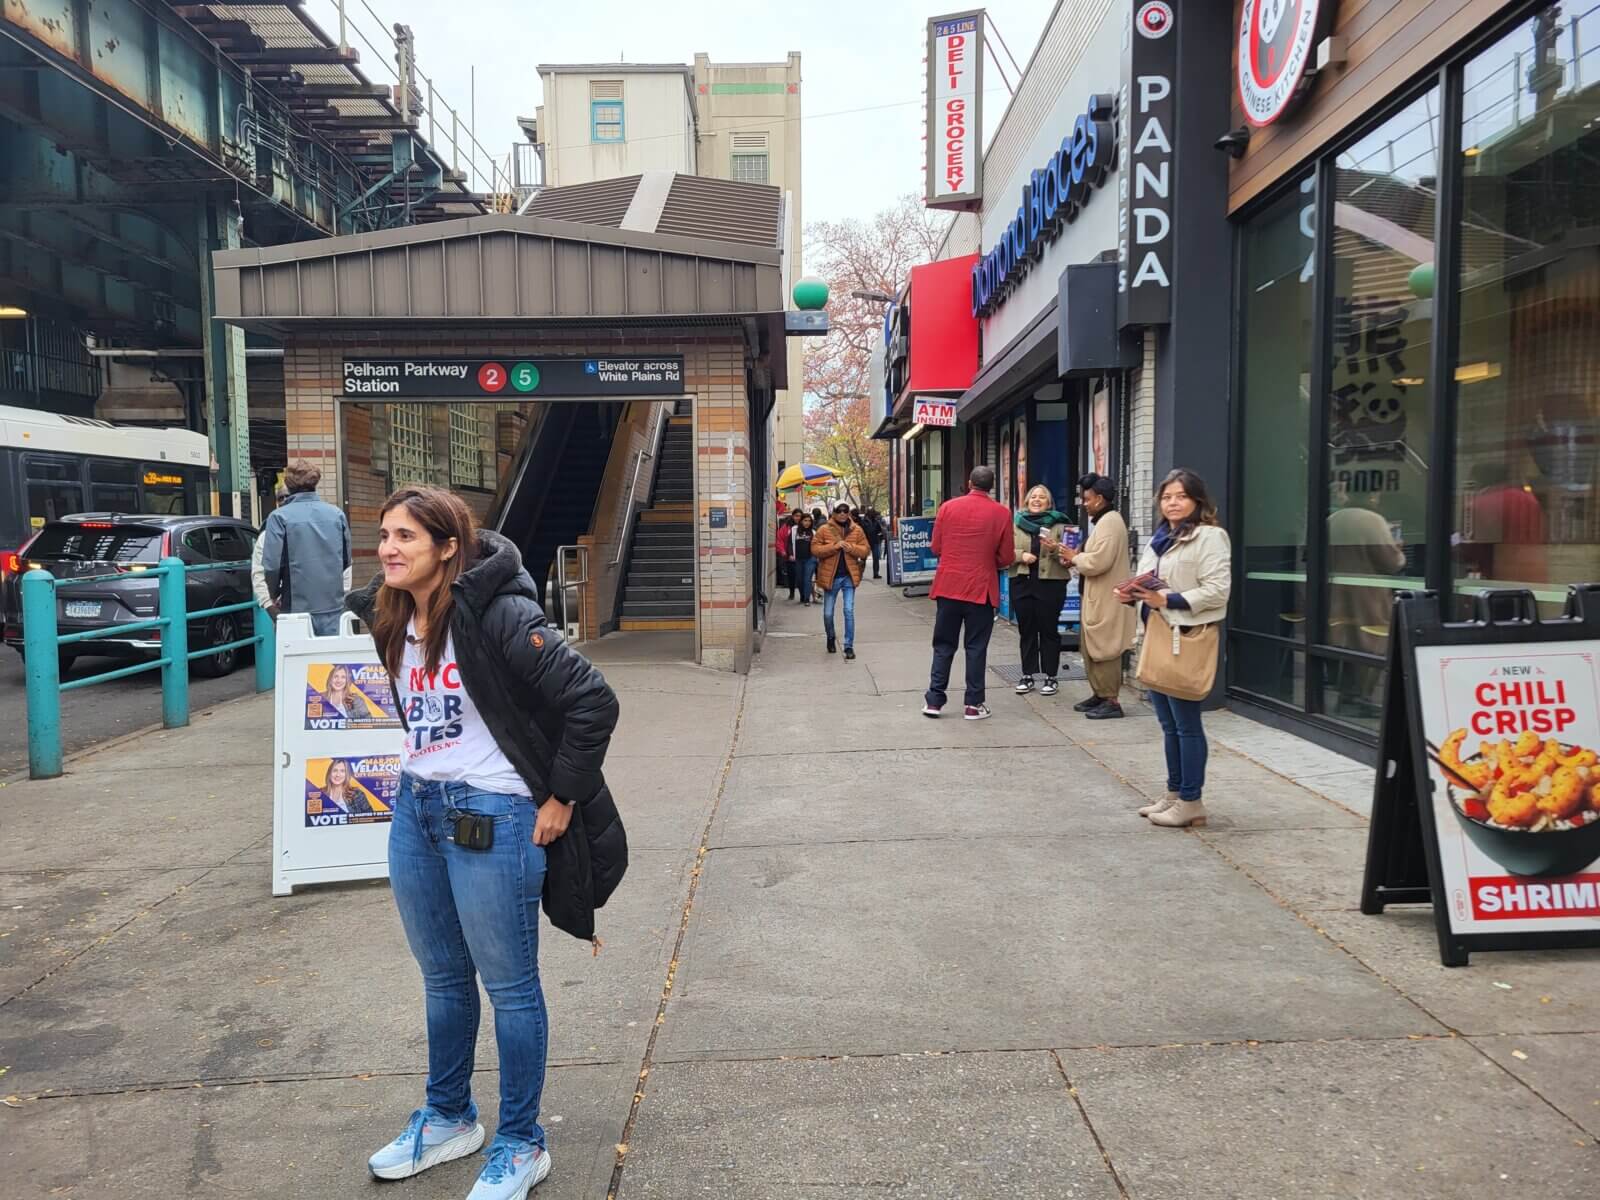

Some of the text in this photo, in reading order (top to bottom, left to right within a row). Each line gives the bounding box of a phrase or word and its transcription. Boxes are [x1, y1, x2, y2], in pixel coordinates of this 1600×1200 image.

[936, 26, 943, 36] 2
[950, 24, 956, 34] 5
[956, 20, 976, 33] LINE
[947, 35, 966, 89] DELI
[1242, 71, 1272, 113] CHINESE
[1274, 10, 1312, 104] KITCHEN
[945, 99, 966, 192] GROCERY
[1131, 75, 1172, 289] PANDA
[971, 184, 1032, 319] Damond
[343, 362, 532, 385] Pelham Parkway 2 5
[598, 361, 679, 371] Elevator across
[598, 372, 680, 381] White Plains Rd
[344, 378, 400, 393] Station
[918, 404, 953, 418] ATM
[917, 416, 953, 425] INSIDE
[1329, 469, 1401, 493] ANDA
[902, 523, 914, 532] No
[902, 532, 928, 540] Credit
[902, 540, 932, 549] Neede
[352, 666, 389, 680] VELAZ
[409, 663, 461, 692] NYC
[1502, 666, 1532, 676] NEW
[1474, 680, 1566, 707] CHILI
[310, 719, 346, 729] VOTE
[1470, 708, 1576, 736] CRISP
[413, 718, 463, 750] TES
[350, 760, 400, 775] VELAZQU
[310, 815, 347, 826] VOTE
[1477, 882, 1600, 913] SHRIM
